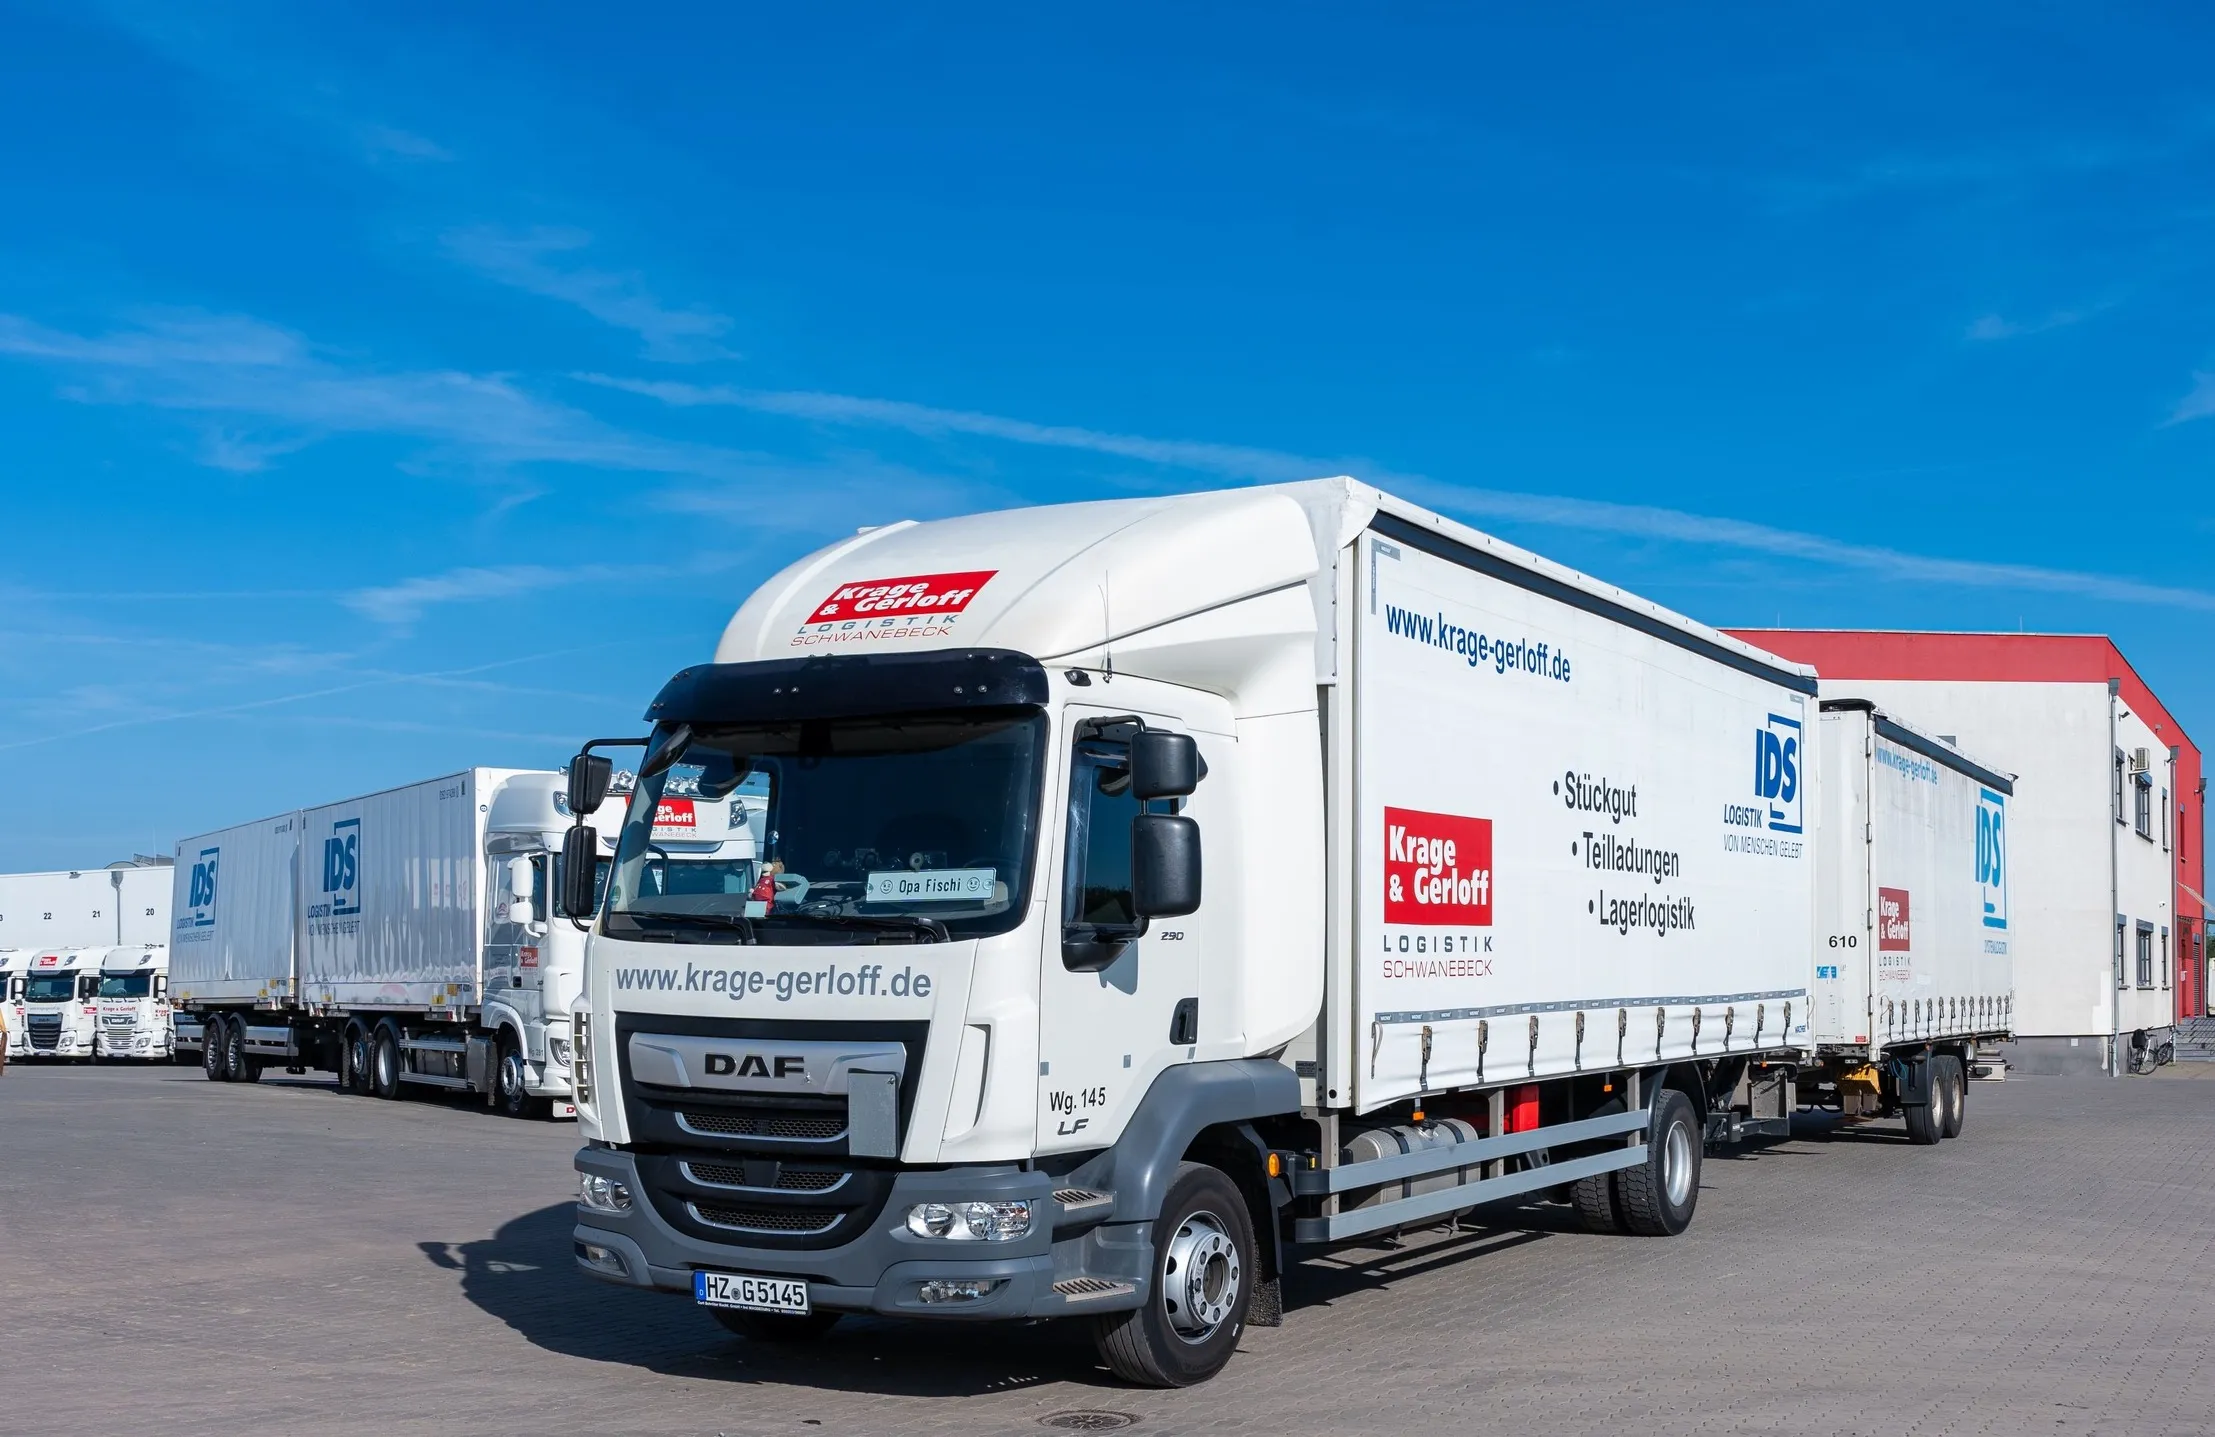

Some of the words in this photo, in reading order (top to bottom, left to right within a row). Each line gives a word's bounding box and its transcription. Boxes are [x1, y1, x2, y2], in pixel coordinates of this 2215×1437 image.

[819, 603, 840, 616] &
[853, 589, 974, 612] Gerloff
[833, 582, 930, 601] Krage
[790, 626, 953, 647] SCHWANEBECK
[797, 614, 959, 635] LOGISTIK
[1385, 603, 1571, 683] www.krage-gerloff.de
[1755, 728, 1797, 804] IDS
[1564, 770, 1637, 825] Stückgut
[654, 812, 694, 823] erloff
[1723, 803, 1763, 829] LOGISTIK
[1389, 825, 1457, 875] Krage
[1582, 831, 1680, 885] Teilladungen
[1723, 833, 1739, 852] VON
[1740, 835, 1778, 857] MENSCHEN
[1779, 840, 1803, 859] GELEBT
[1975, 804, 2001, 888] IDS
[323, 833, 357, 893] IDS
[189, 860, 216, 908] IDS
[898, 879, 920, 896] Opa
[926, 878, 961, 893] Fischi
[1389, 873, 1405, 903] &
[1413, 867, 1490, 906] Gerloff
[43, 912, 52, 920] 22
[92, 910, 101, 918] 21
[145, 908, 155, 916] 20
[1599, 889, 1696, 938] Lagerlogistik
[1880, 896, 1900, 922] Krage
[1160, 931, 1184, 941] 290
[1383, 934, 1493, 953] LOGISTIK
[1828, 935, 1857, 948] 610
[1383, 959, 1493, 978] SCHWANEBECK
[616, 962, 932, 1002] www.krage-gerloff.de
[704, 1053, 805, 1079] DAF
[1049, 1090, 1077, 1115] Wg.
[1081, 1086, 1106, 1108] 145
[1057, 1118, 1089, 1136] LF
[706, 1276, 731, 1300] HZ
